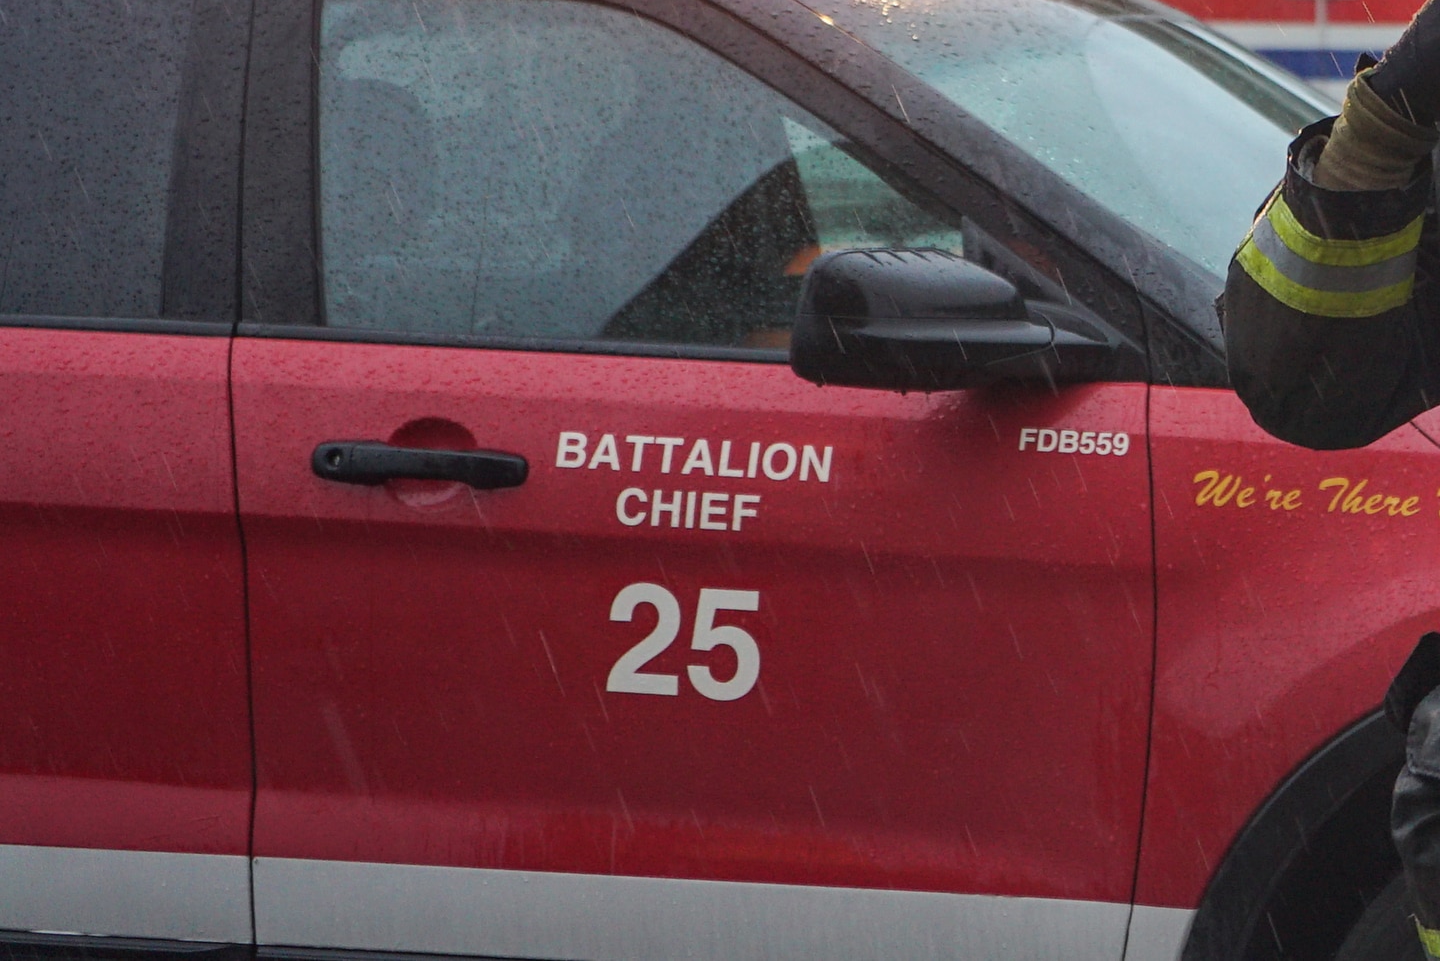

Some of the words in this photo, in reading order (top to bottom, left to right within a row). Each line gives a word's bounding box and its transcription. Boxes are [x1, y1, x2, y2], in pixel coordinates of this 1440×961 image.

[555, 432, 833, 482] BATTALION
[1018, 428, 1129, 456] FDB559
[616, 487, 760, 532] CHIEF
[1193, 471, 1302, 511] We're
[1318, 477, 1421, 517] There
[606, 582, 760, 701] 25
